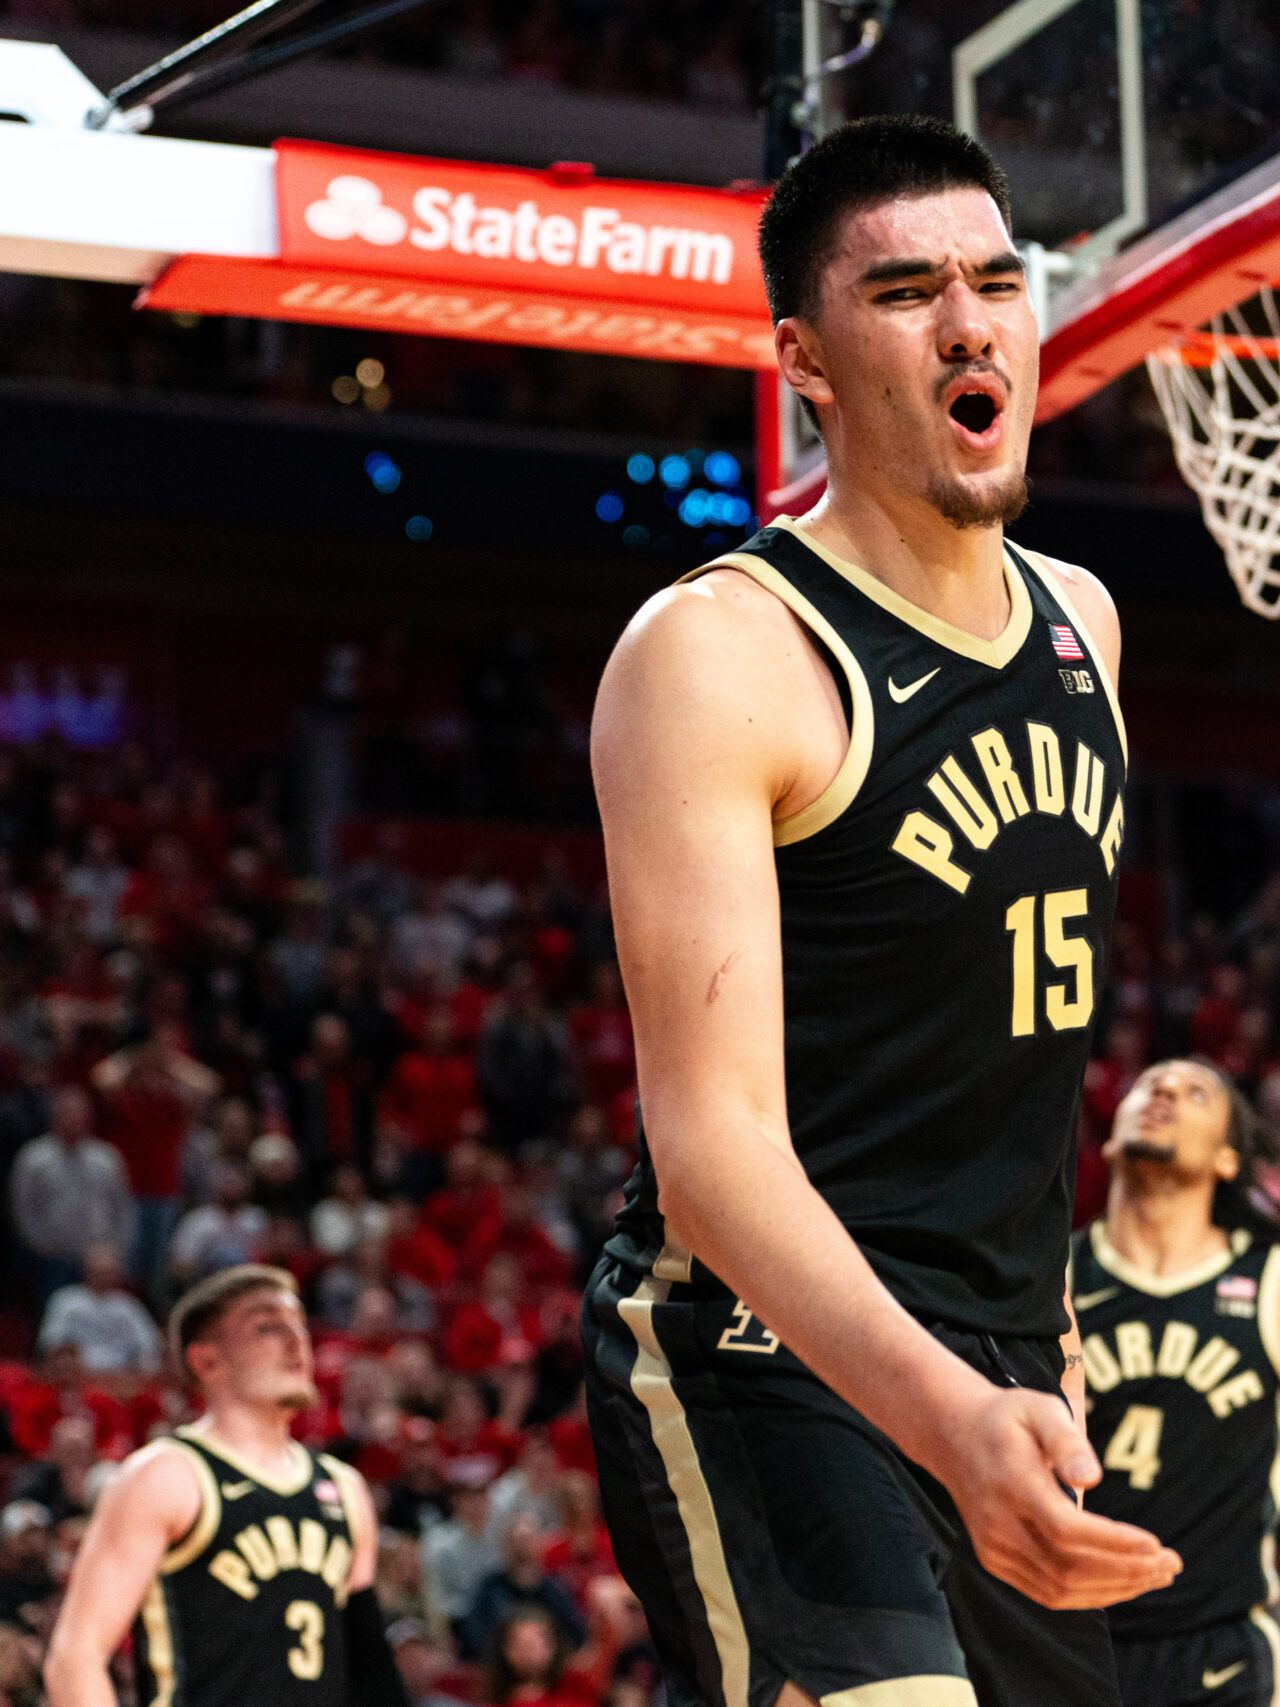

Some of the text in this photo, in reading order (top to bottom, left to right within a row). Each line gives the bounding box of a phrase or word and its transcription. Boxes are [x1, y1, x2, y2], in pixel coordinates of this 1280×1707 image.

[1005, 887, 1094, 1038] 15
[1083, 1319, 1265, 1420] URDUE
[1103, 1404, 1166, 1490] 4
[208, 1515, 350, 1608] PURDU
[284, 1599, 327, 1681] 3
